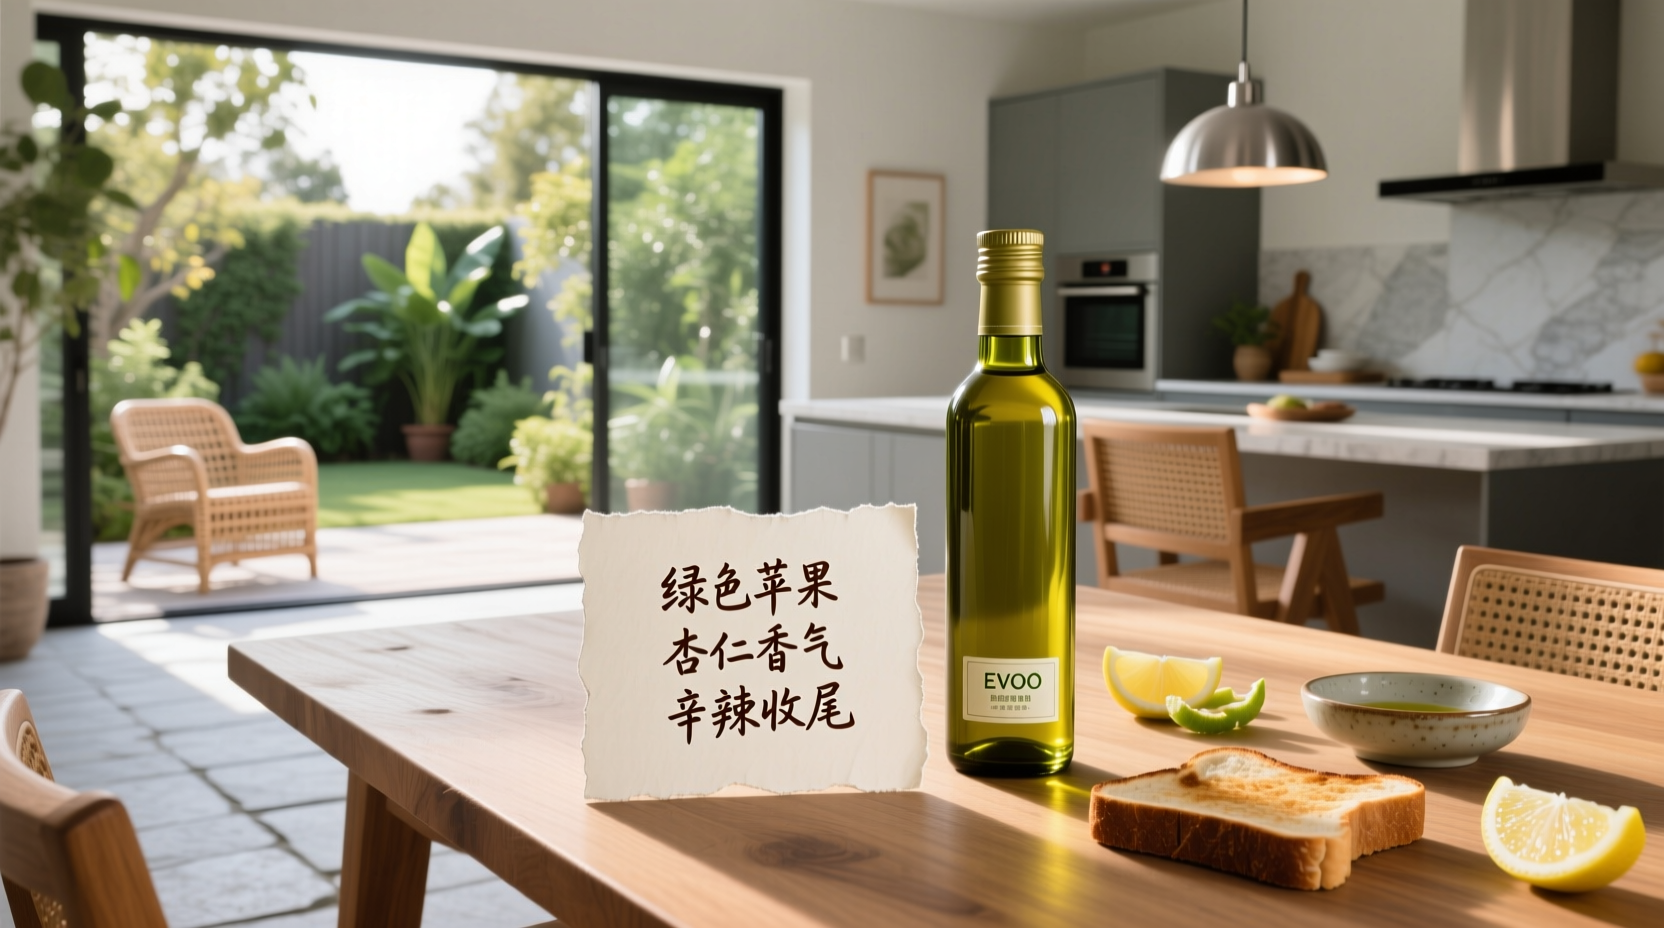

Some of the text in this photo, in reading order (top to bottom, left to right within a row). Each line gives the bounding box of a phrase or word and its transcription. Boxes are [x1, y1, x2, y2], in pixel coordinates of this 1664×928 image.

[660, 557, 839, 616] 绿色苹果
[662, 622, 844, 676] 杏仁香气
[984, 672, 1042, 690] EVOO
[667, 681, 856, 745] 辛辣收尾
